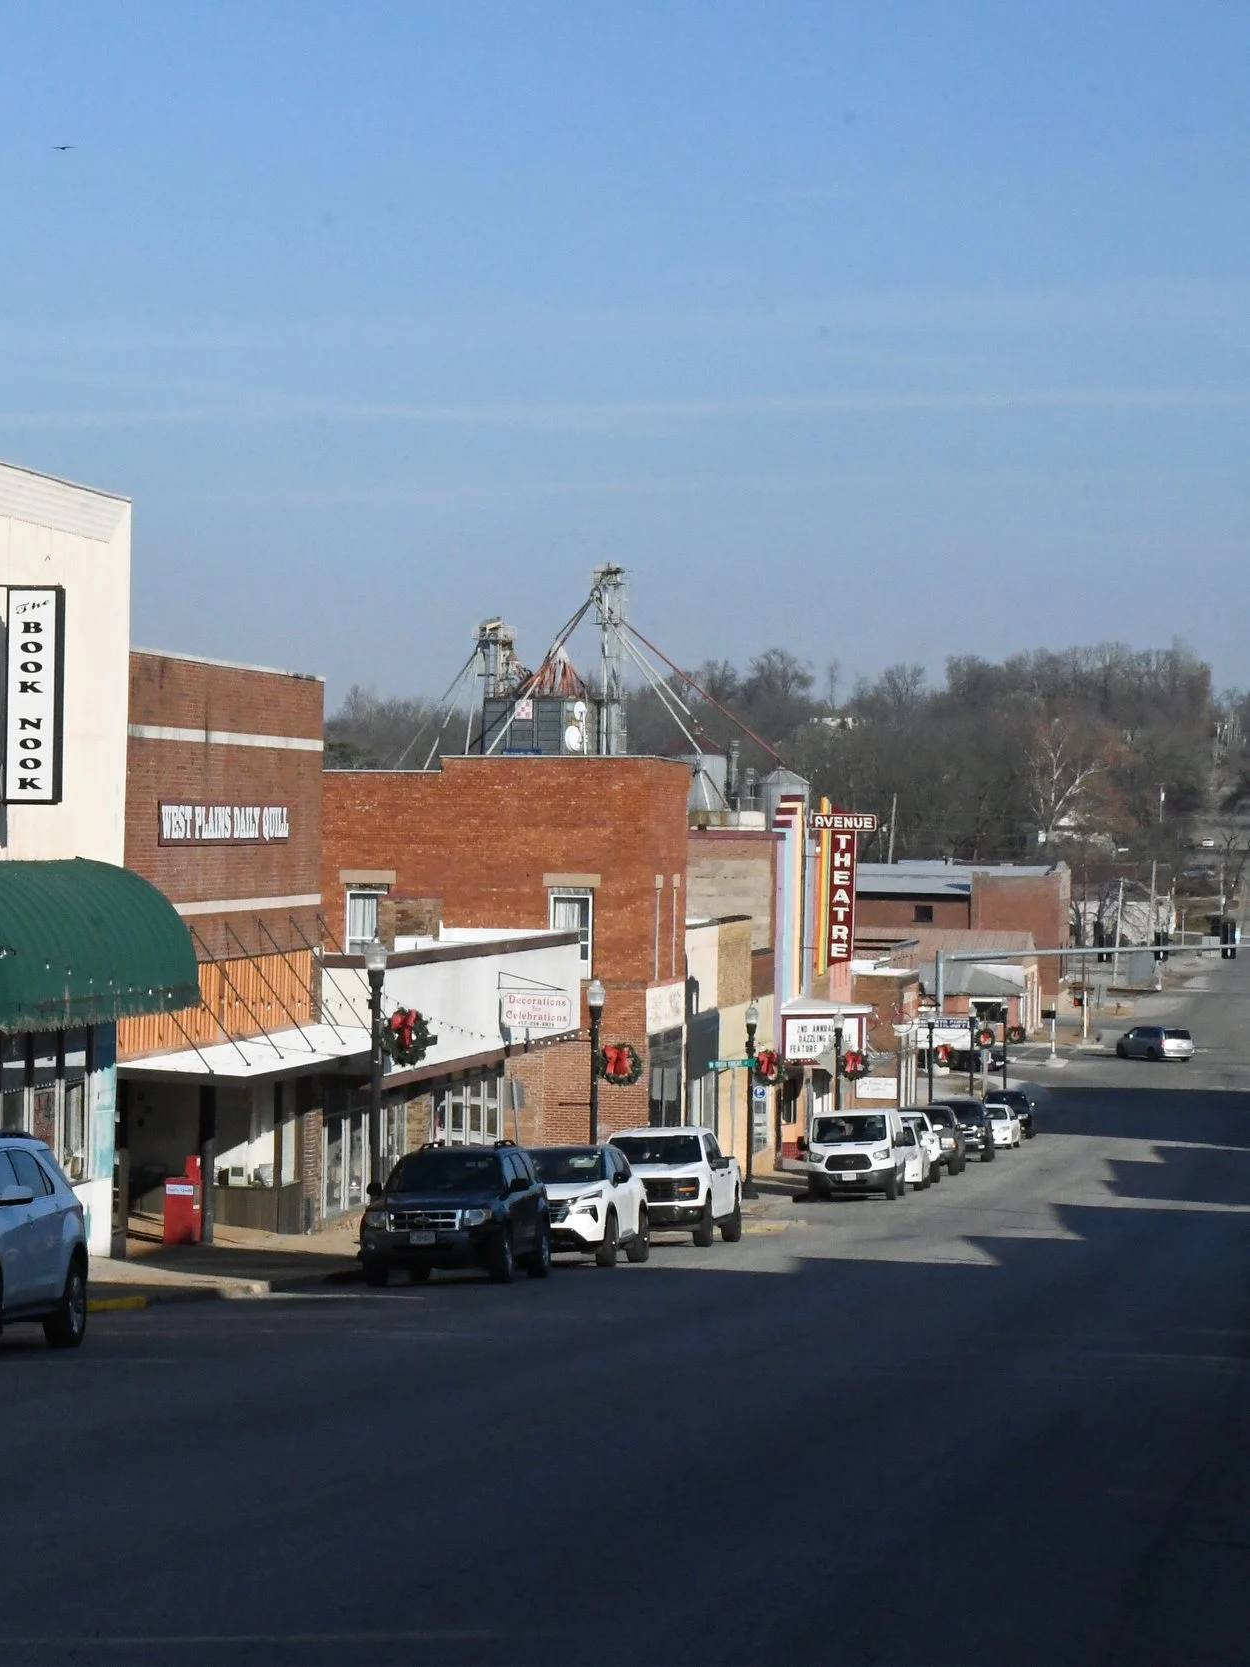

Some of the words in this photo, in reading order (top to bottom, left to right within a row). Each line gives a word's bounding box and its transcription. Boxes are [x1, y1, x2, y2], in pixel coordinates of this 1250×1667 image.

[16, 599, 50, 615] The
[19, 621, 44, 694] BOOK
[18, 718, 43, 790] NOOK
[161, 805, 193, 840] WEST
[194, 805, 232, 840] PLAINS
[233, 806, 261, 839] DAILY
[262, 806, 290, 842] QUILL
[814, 815, 874, 829] AVENUE
[831, 834, 852, 958] THEATRE
[508, 994, 567, 1007] Decorations
[505, 1010, 568, 1022] Celebrations
[789, 1044, 818, 1054] FEATURE
